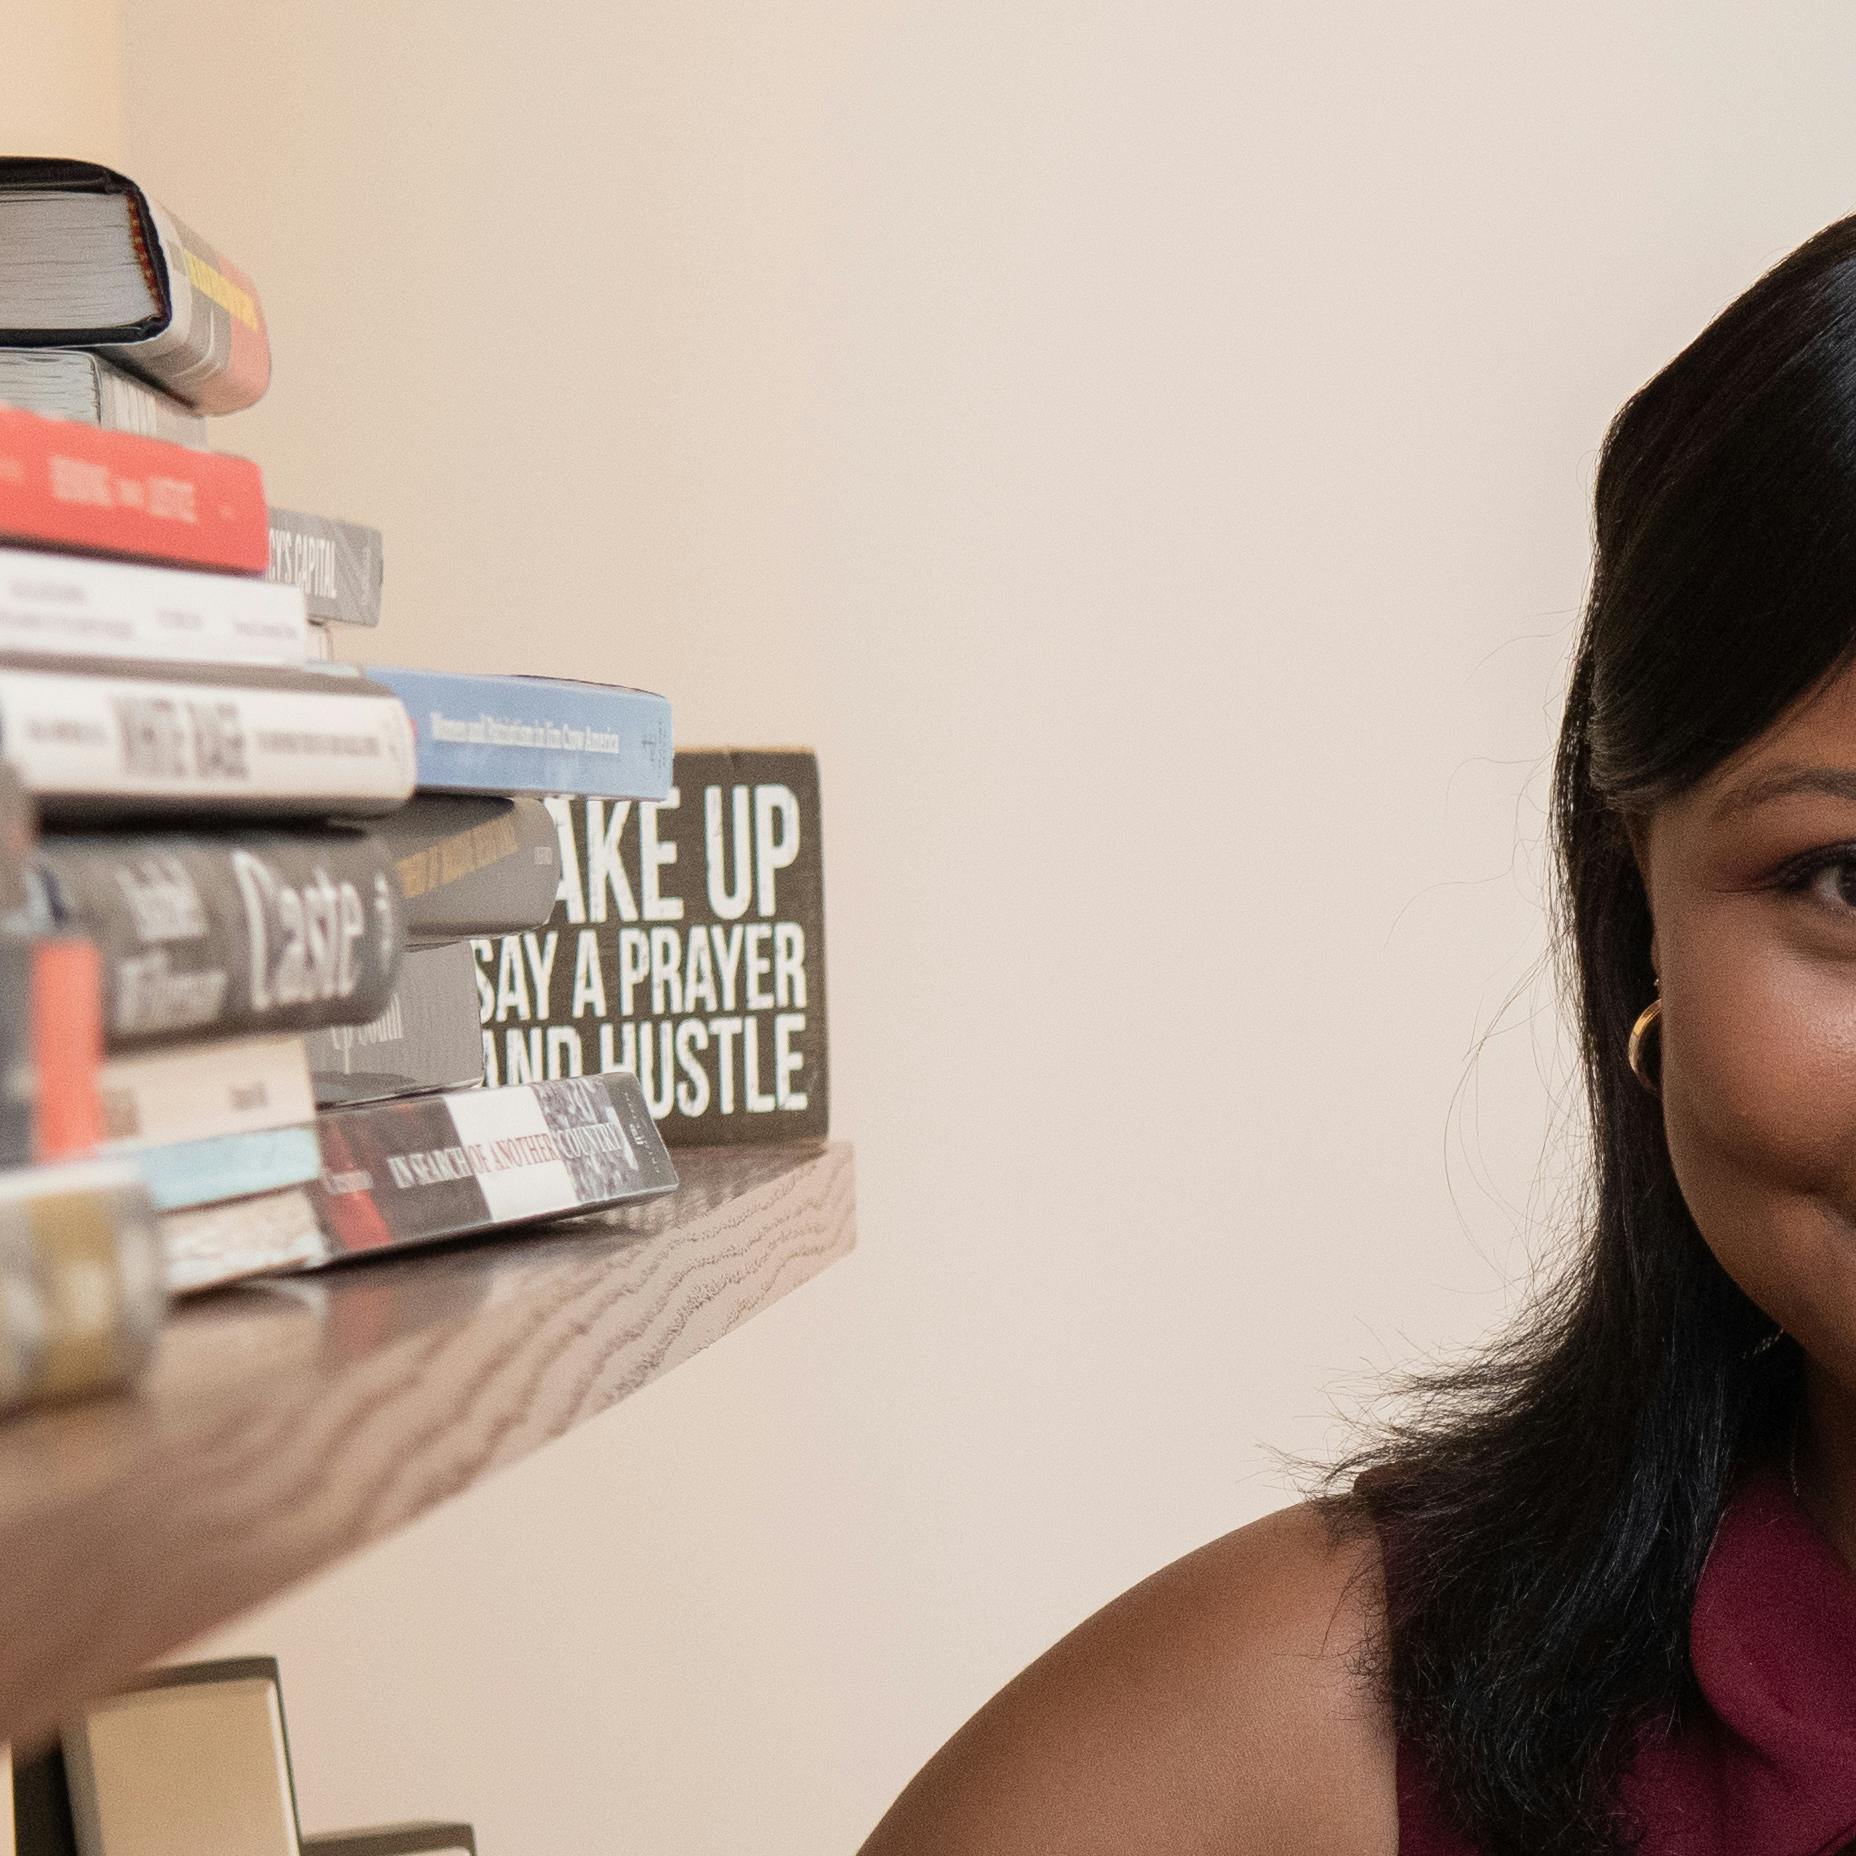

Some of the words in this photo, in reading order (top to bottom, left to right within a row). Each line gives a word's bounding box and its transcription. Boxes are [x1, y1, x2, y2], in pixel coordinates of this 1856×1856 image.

[543, 786, 685, 925] AKE
[703, 784, 801, 921] UP
[470, 930, 559, 1025] SAY
[571, 928, 607, 1019] A
[619, 921, 808, 1017] PRAYER
[600, 1013, 808, 1120] HUSTLE
[410, 1146, 475, 1186] SEARCH
[489, 1132, 561, 1173] ANOTHER
[556, 1121, 623, 1160] COUNTRY
